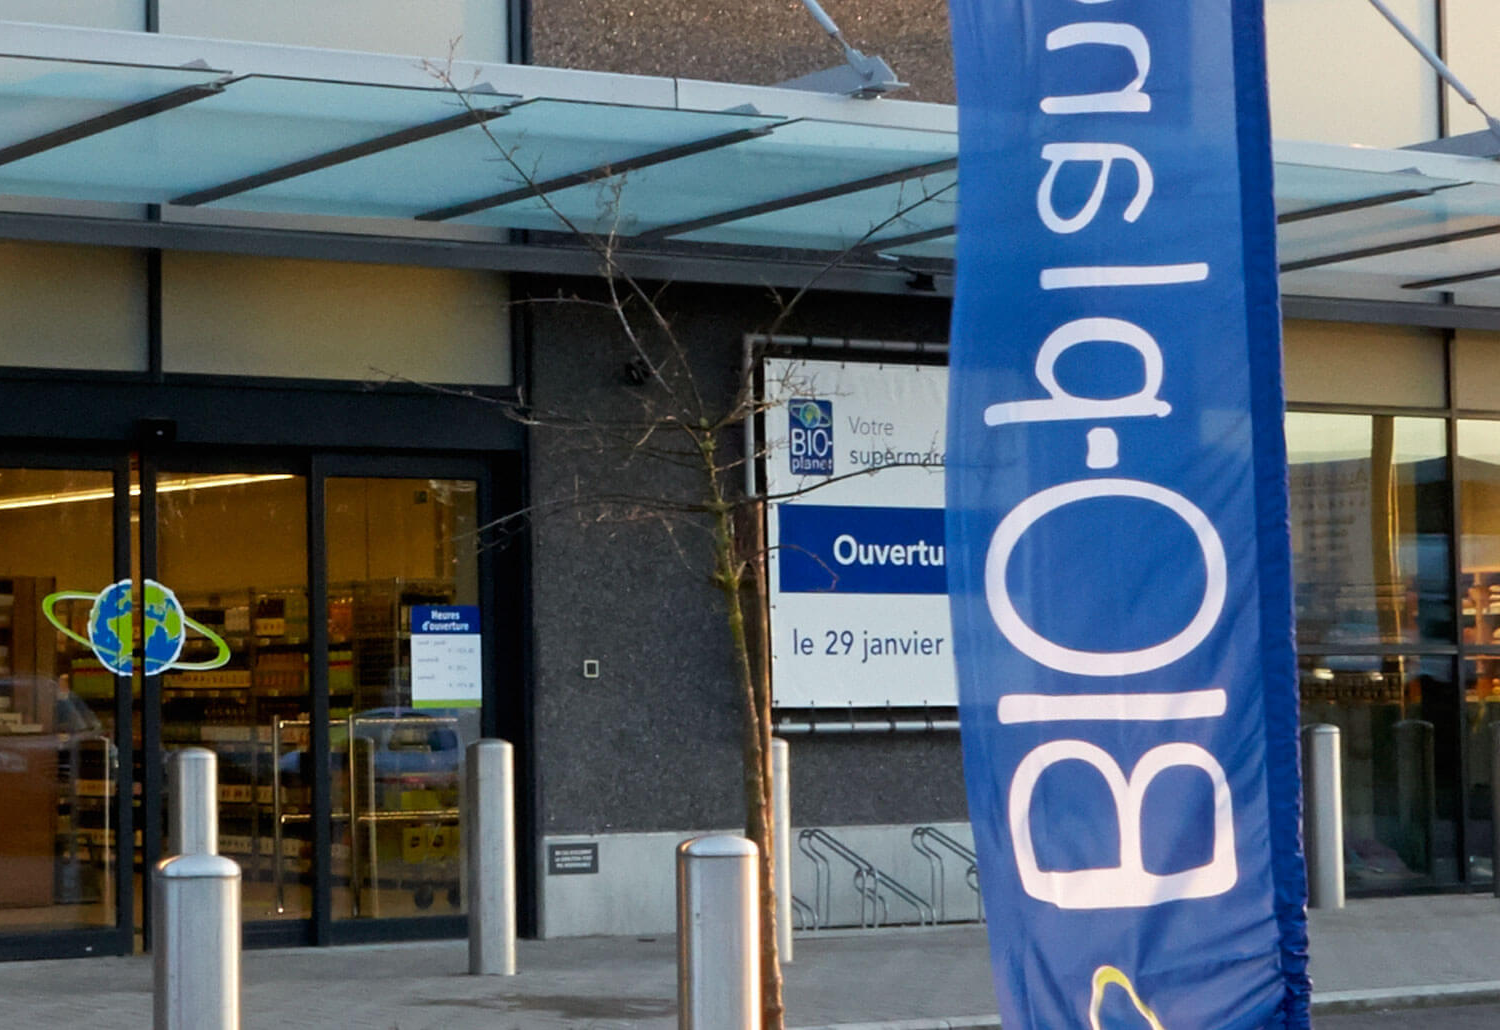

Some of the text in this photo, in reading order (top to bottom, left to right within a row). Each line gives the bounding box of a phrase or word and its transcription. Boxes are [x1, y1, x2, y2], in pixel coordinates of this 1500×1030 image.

[848, 416, 894, 436] Votre
[791, 428, 833, 456] BIO-
[985, 0, 1238, 909] BIO-plan
[834, 534, 945, 566] Ouvertu
[422, 620, 469, 631] d'ouverture
[431, 609, 460, 620] Heures
[793, 628, 944, 664] le 29 janvier
